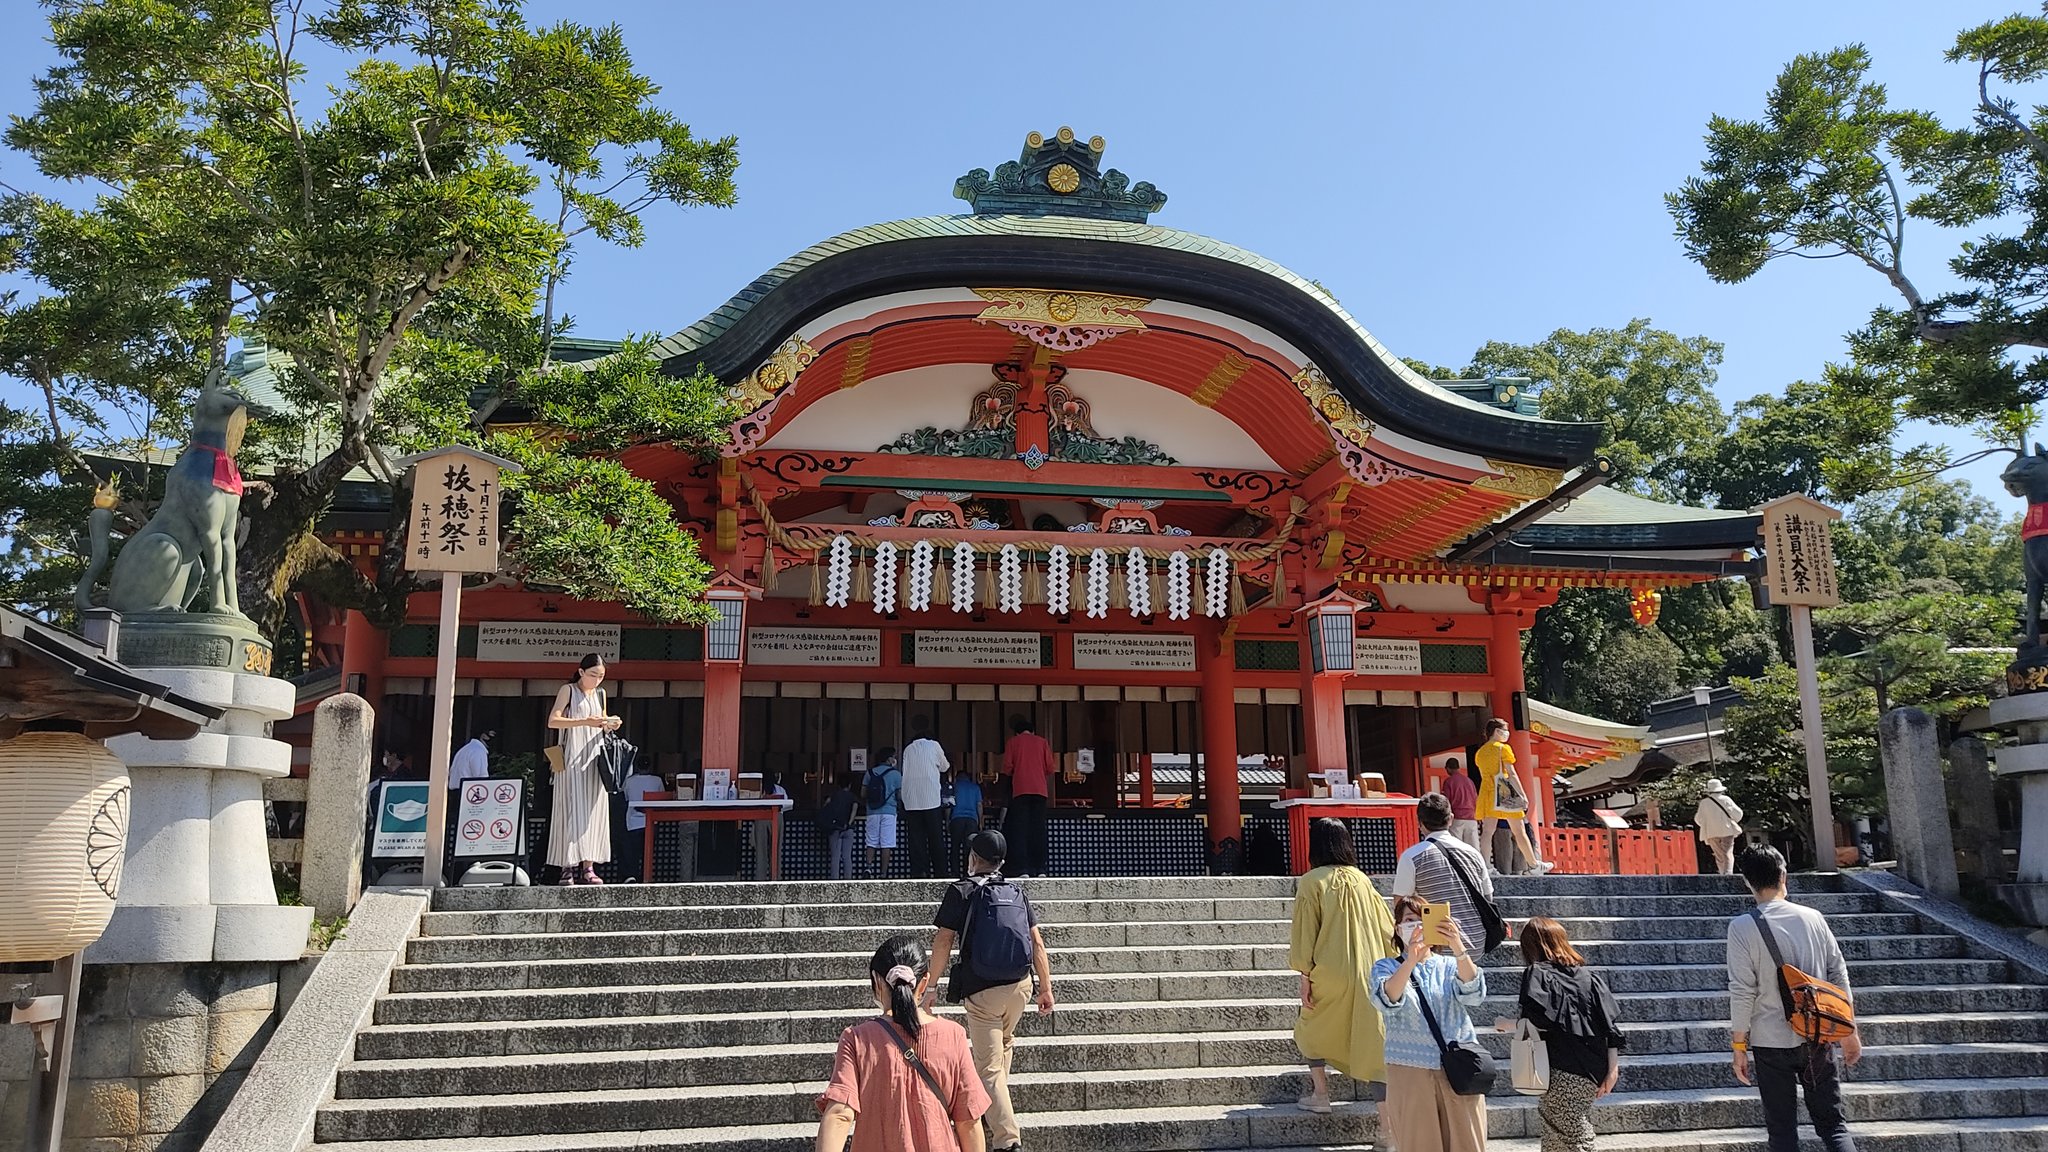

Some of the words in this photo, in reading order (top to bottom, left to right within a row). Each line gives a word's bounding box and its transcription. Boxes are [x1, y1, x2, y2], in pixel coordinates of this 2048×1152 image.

[438, 463, 477, 555] 抜穂祭
[476, 480, 492, 546] 十月二十五日
[417, 502, 432, 559] 午前十一時
[1784, 513, 1812, 595] 講員大祭
[482, 627, 586, 637] 新型コロナウイルス感染拡大防止の為
[587, 628, 618, 637] 距離を保ち
[752, 632, 848, 642] 新型コロナウイルス感染拡大防止の為
[849, 634, 879, 642] 距離を保ち
[482, 637, 522, 646] マスクを着用し
[525, 638, 617, 647] 大きな声での会話はご遠慮下さい
[751, 643, 789, 651] マスクを着用し
[792, 643, 878, 652] 大きな声での会話はご遠慮下さい
[918, 645, 954, 653] マスクを着用し
[1077, 648, 1112, 656] マスクを着用し
[808, 655, 876, 663] ご協力をお願いいたします
[972, 657, 1037, 666] ご協力をお願いいたします
